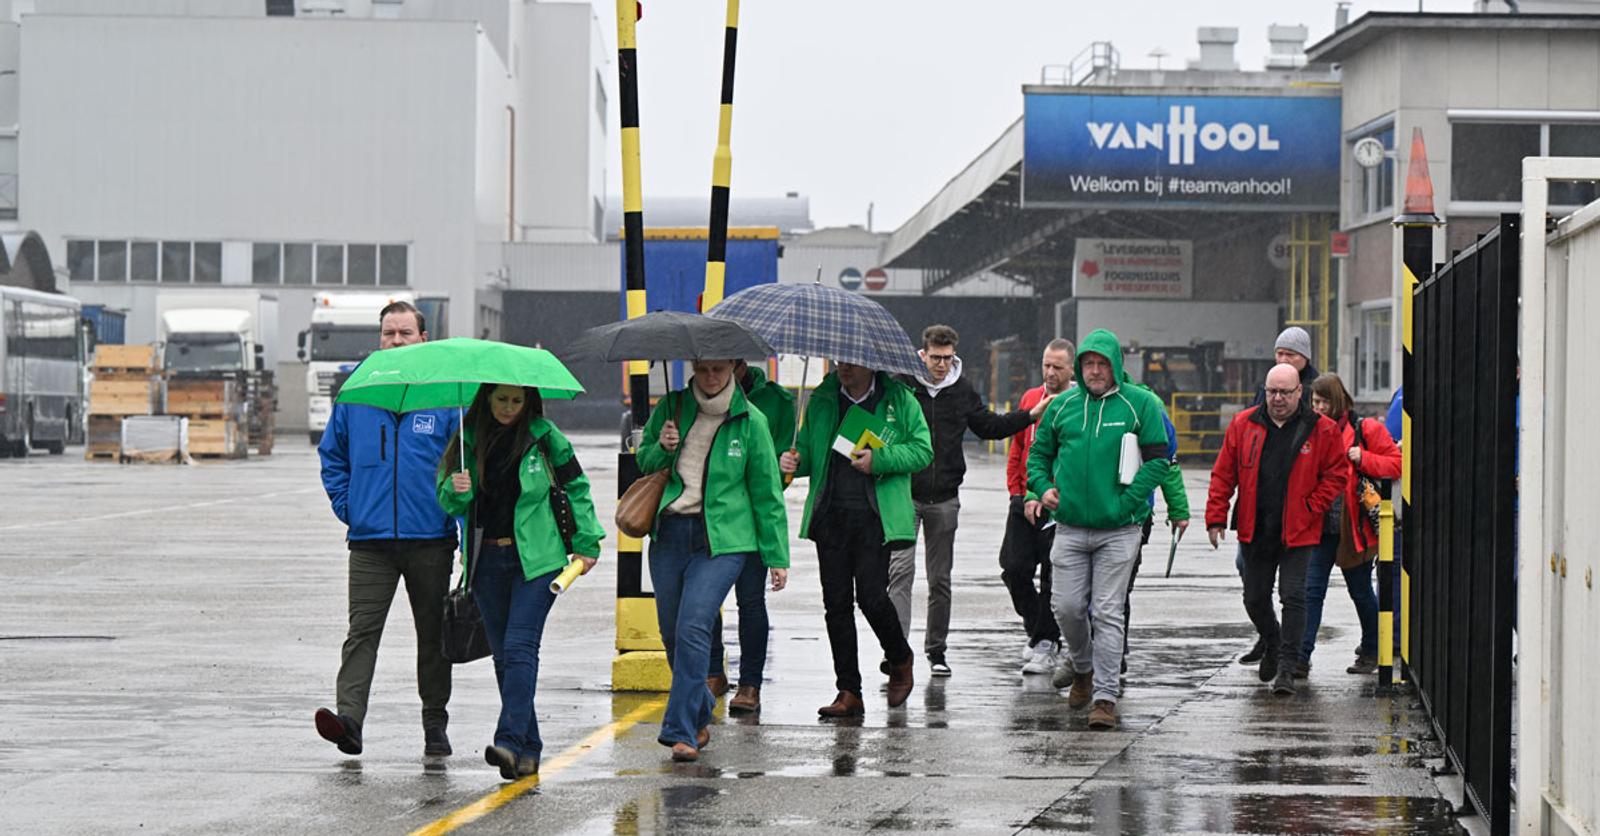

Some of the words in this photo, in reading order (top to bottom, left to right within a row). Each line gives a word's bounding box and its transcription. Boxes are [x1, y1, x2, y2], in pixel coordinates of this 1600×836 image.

[1069, 175, 1140, 193] Welkom
[1144, 175, 1164, 197] bij
[1168, 177, 1292, 196] #teamvanhool!
